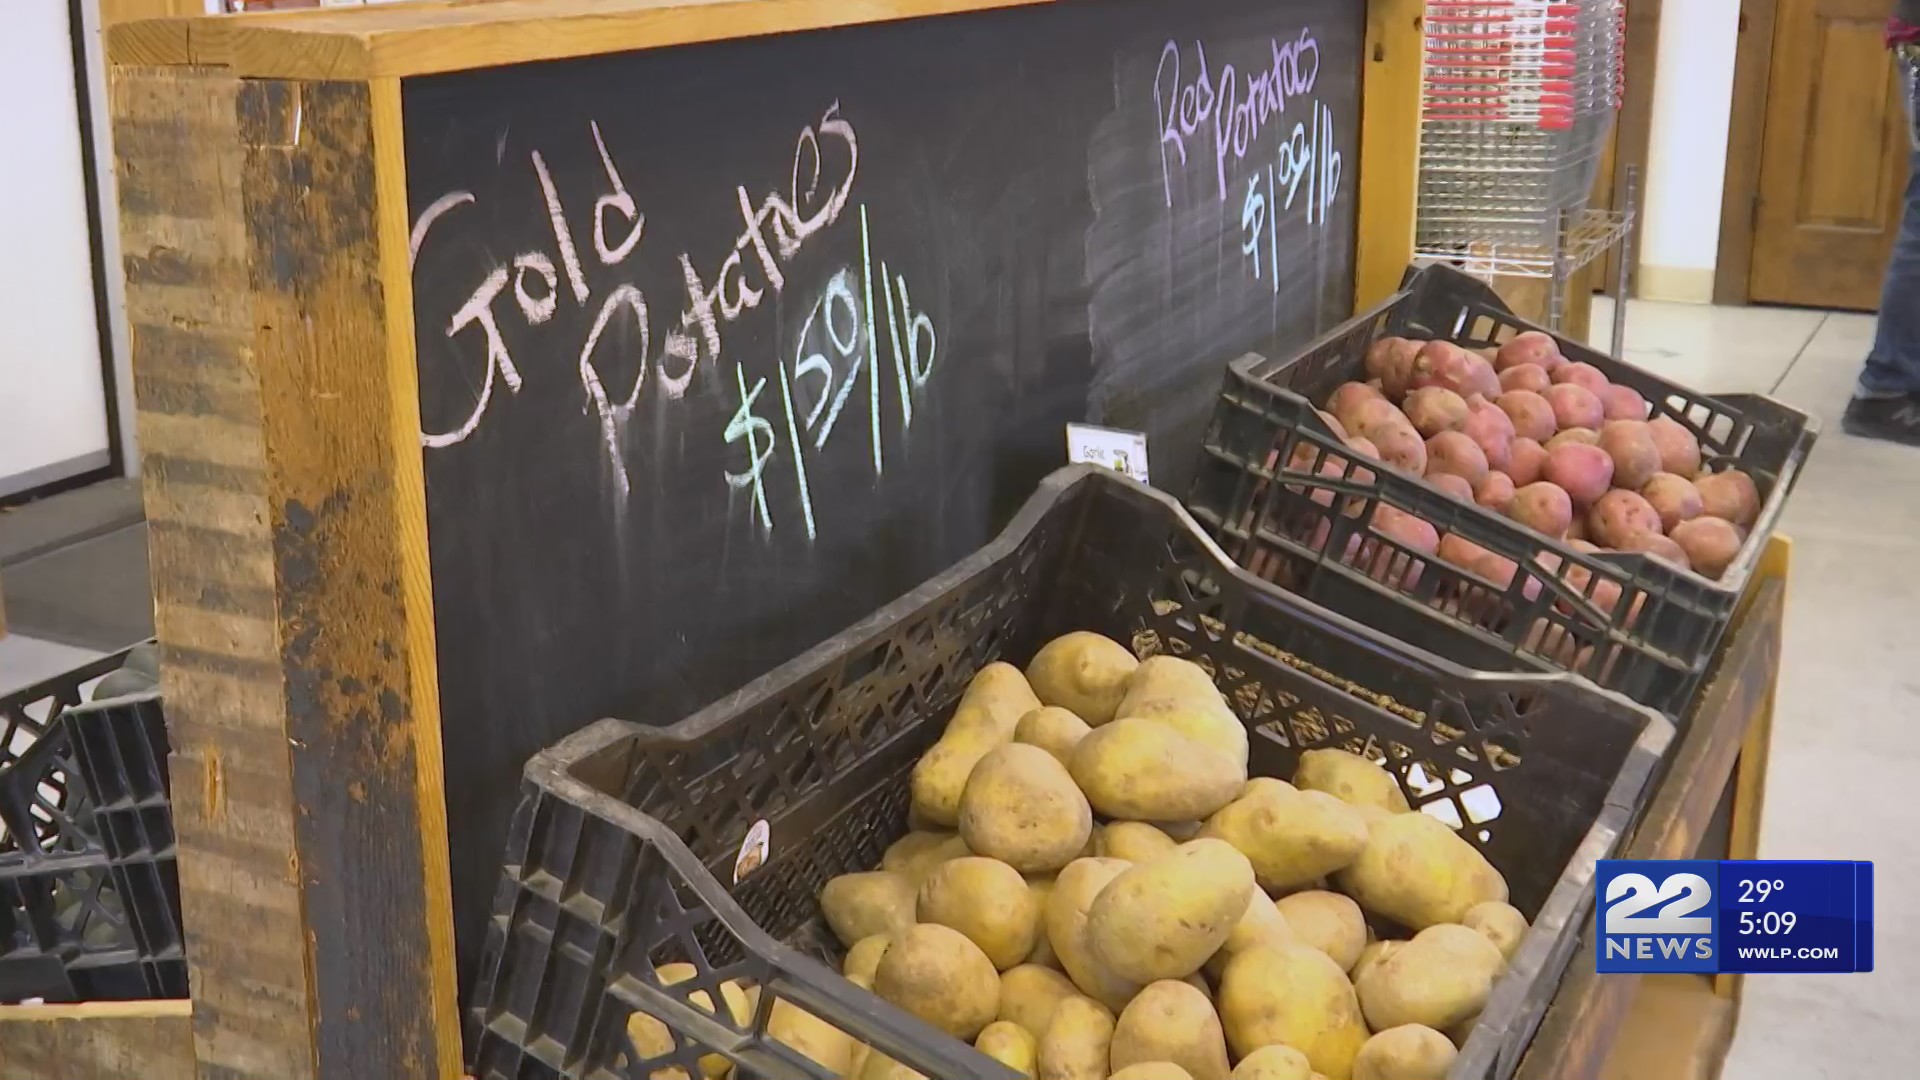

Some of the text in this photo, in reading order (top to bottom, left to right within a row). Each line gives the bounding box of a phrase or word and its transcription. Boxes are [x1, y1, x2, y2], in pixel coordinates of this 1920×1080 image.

[409, 119, 645, 448] Gold
[1154, 39, 1215, 208] Red
[579, 98, 858, 496] Potatoes
